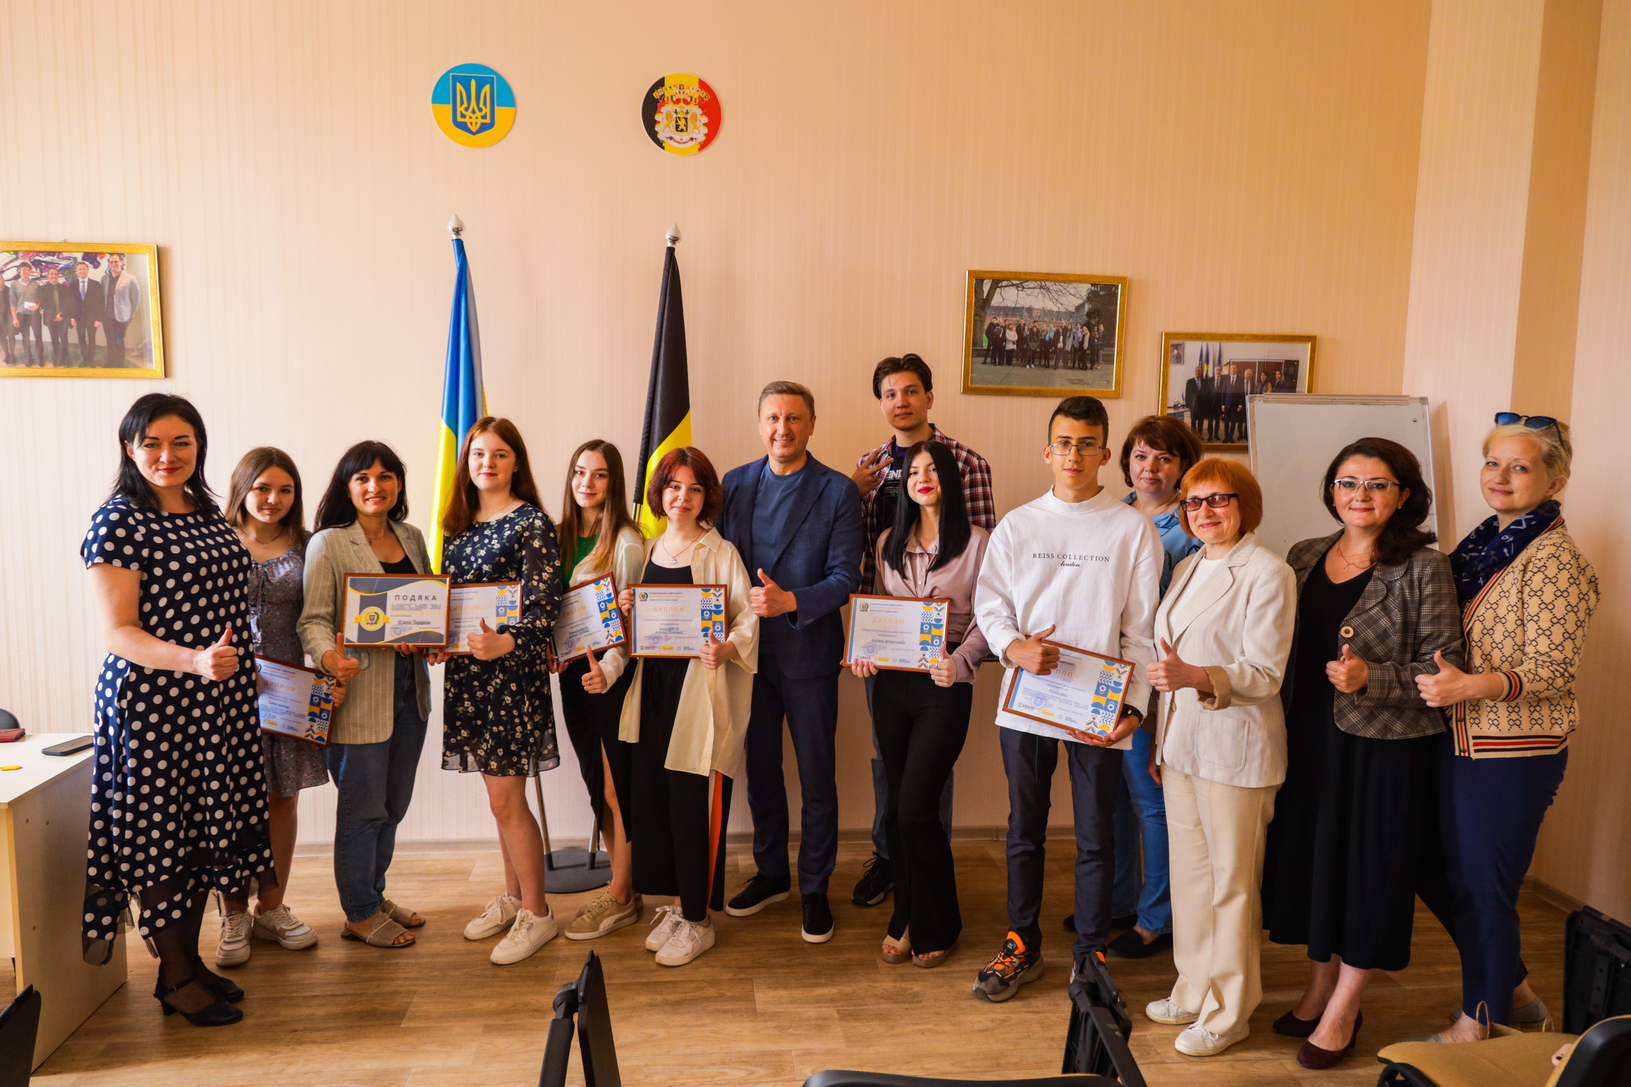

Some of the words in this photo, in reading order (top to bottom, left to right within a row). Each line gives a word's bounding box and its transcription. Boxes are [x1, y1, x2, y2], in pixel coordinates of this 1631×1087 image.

[1056, 553, 1110, 562] COLLECTION
[394, 594, 437, 602] ПОДЯКА
[562, 605, 586, 619] ДИПЛОМ
[264, 680, 296, 692] ДИПЛОМ
